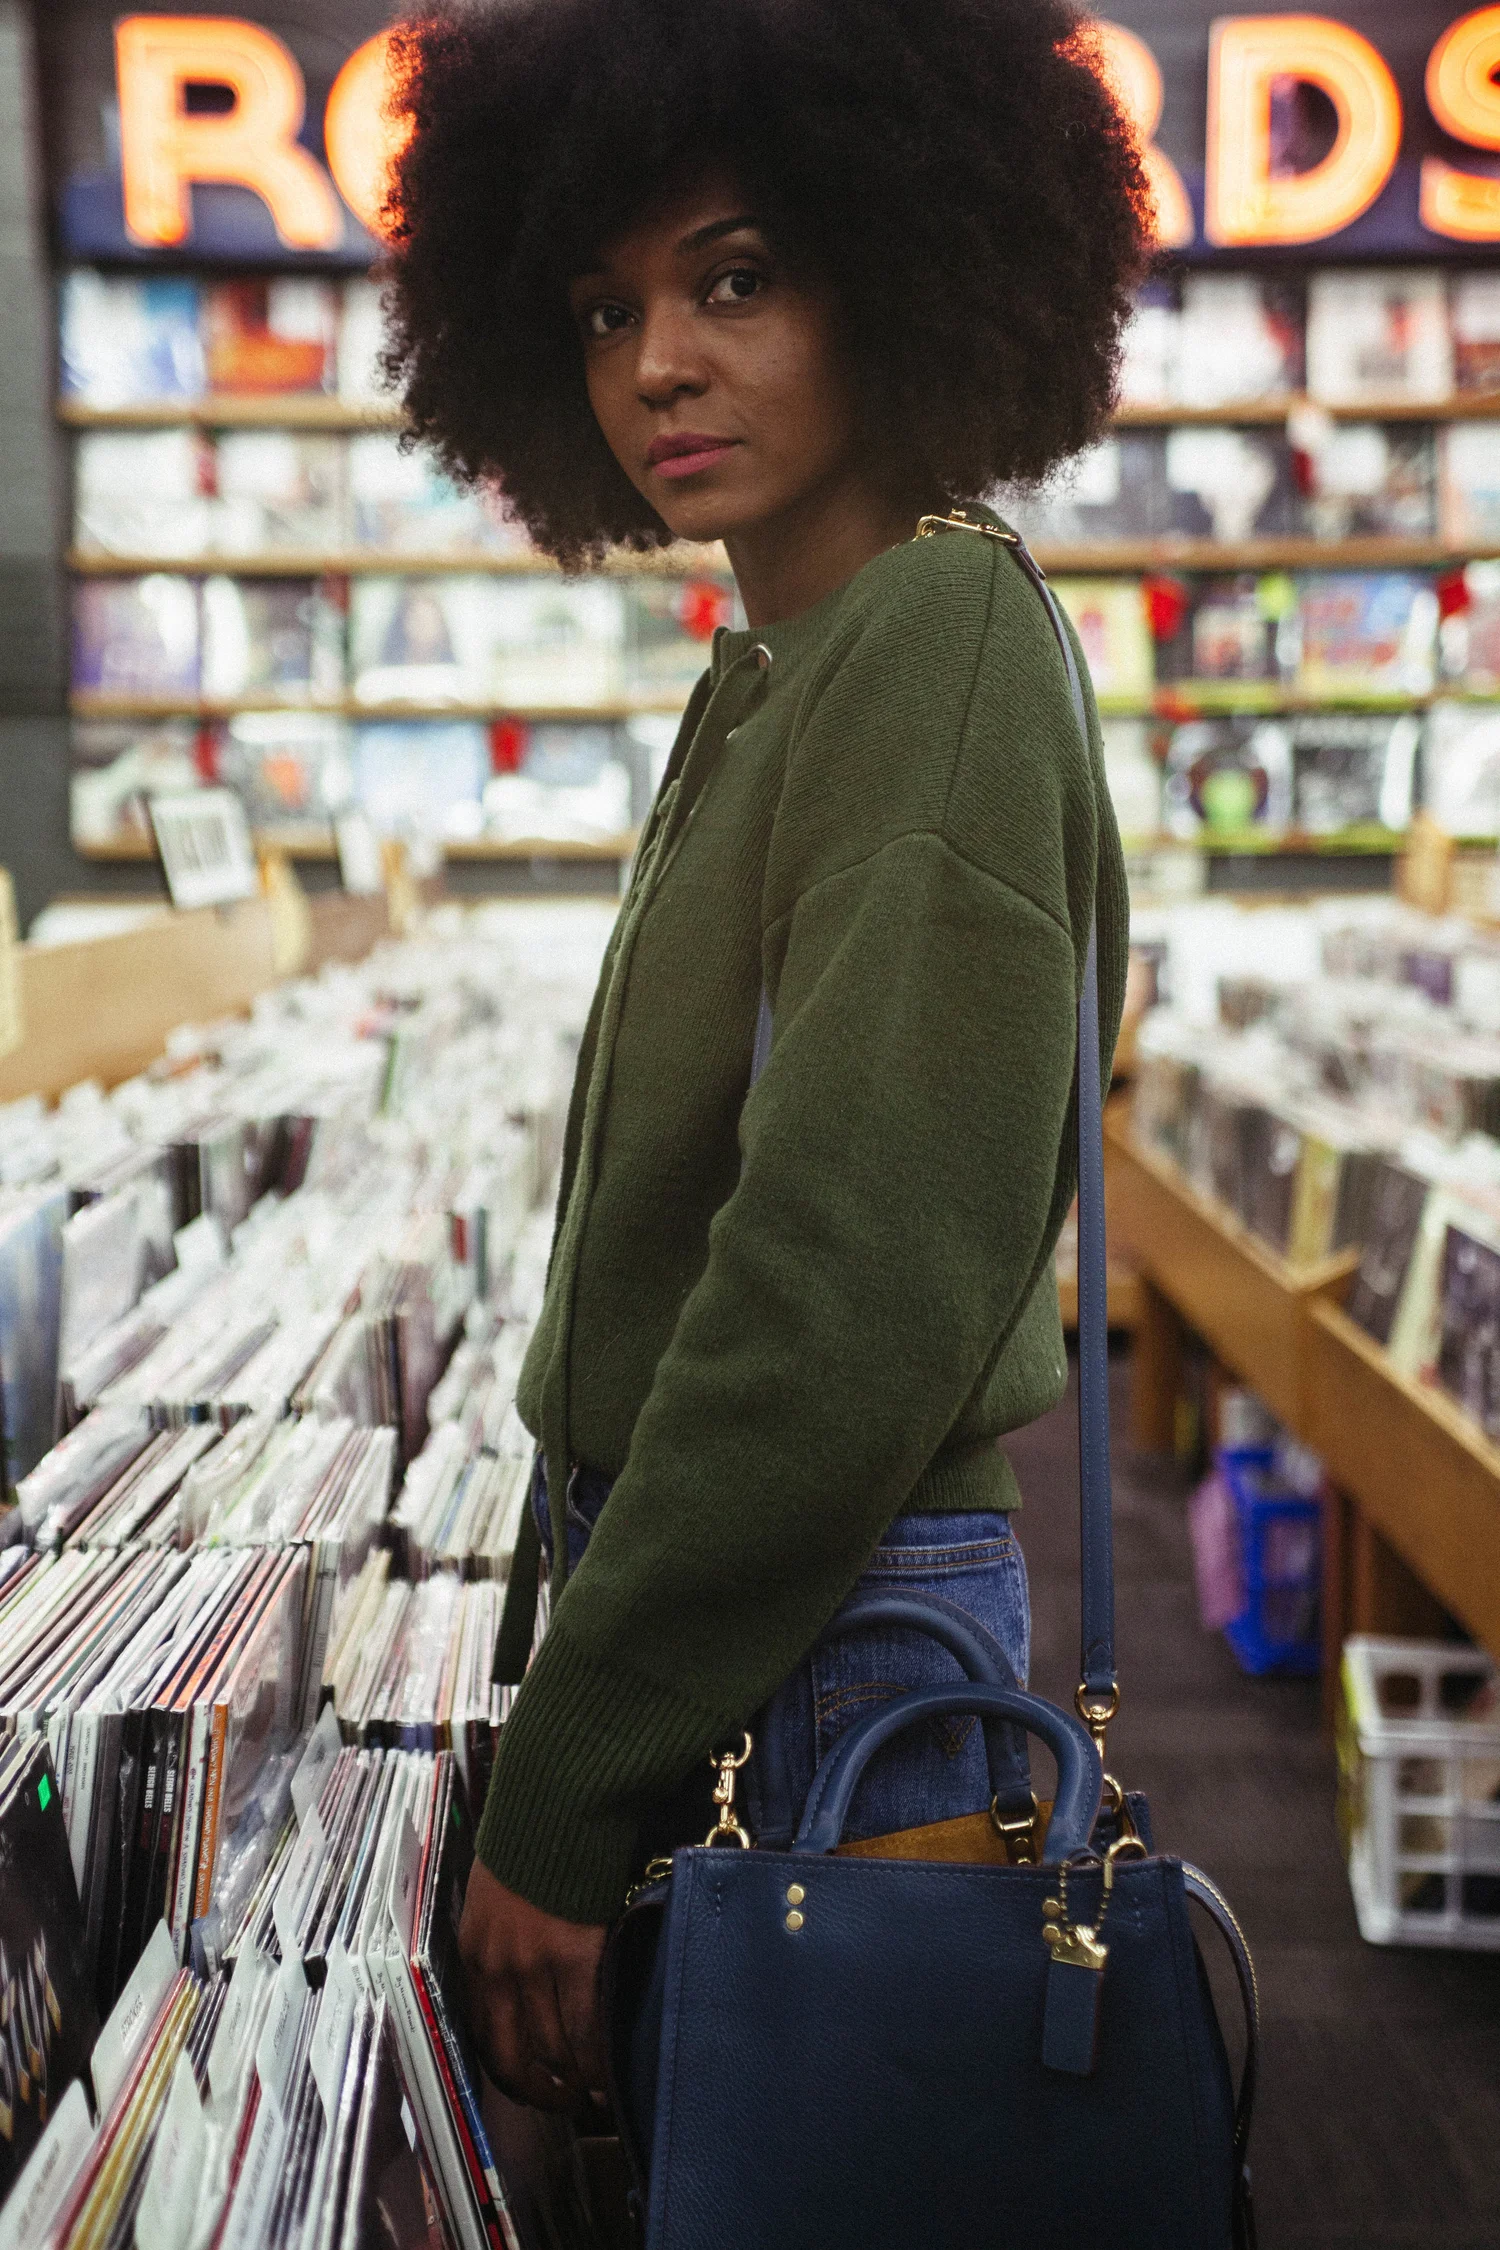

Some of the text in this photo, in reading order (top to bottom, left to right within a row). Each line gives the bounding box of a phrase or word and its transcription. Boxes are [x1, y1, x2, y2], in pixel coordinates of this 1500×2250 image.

[146, 1766, 156, 1788] SLEIGH
[165, 1769, 176, 1793] SLEIGH
[145, 1789, 154, 1809] BELLS
[163, 1793, 174, 1813] BELLS
